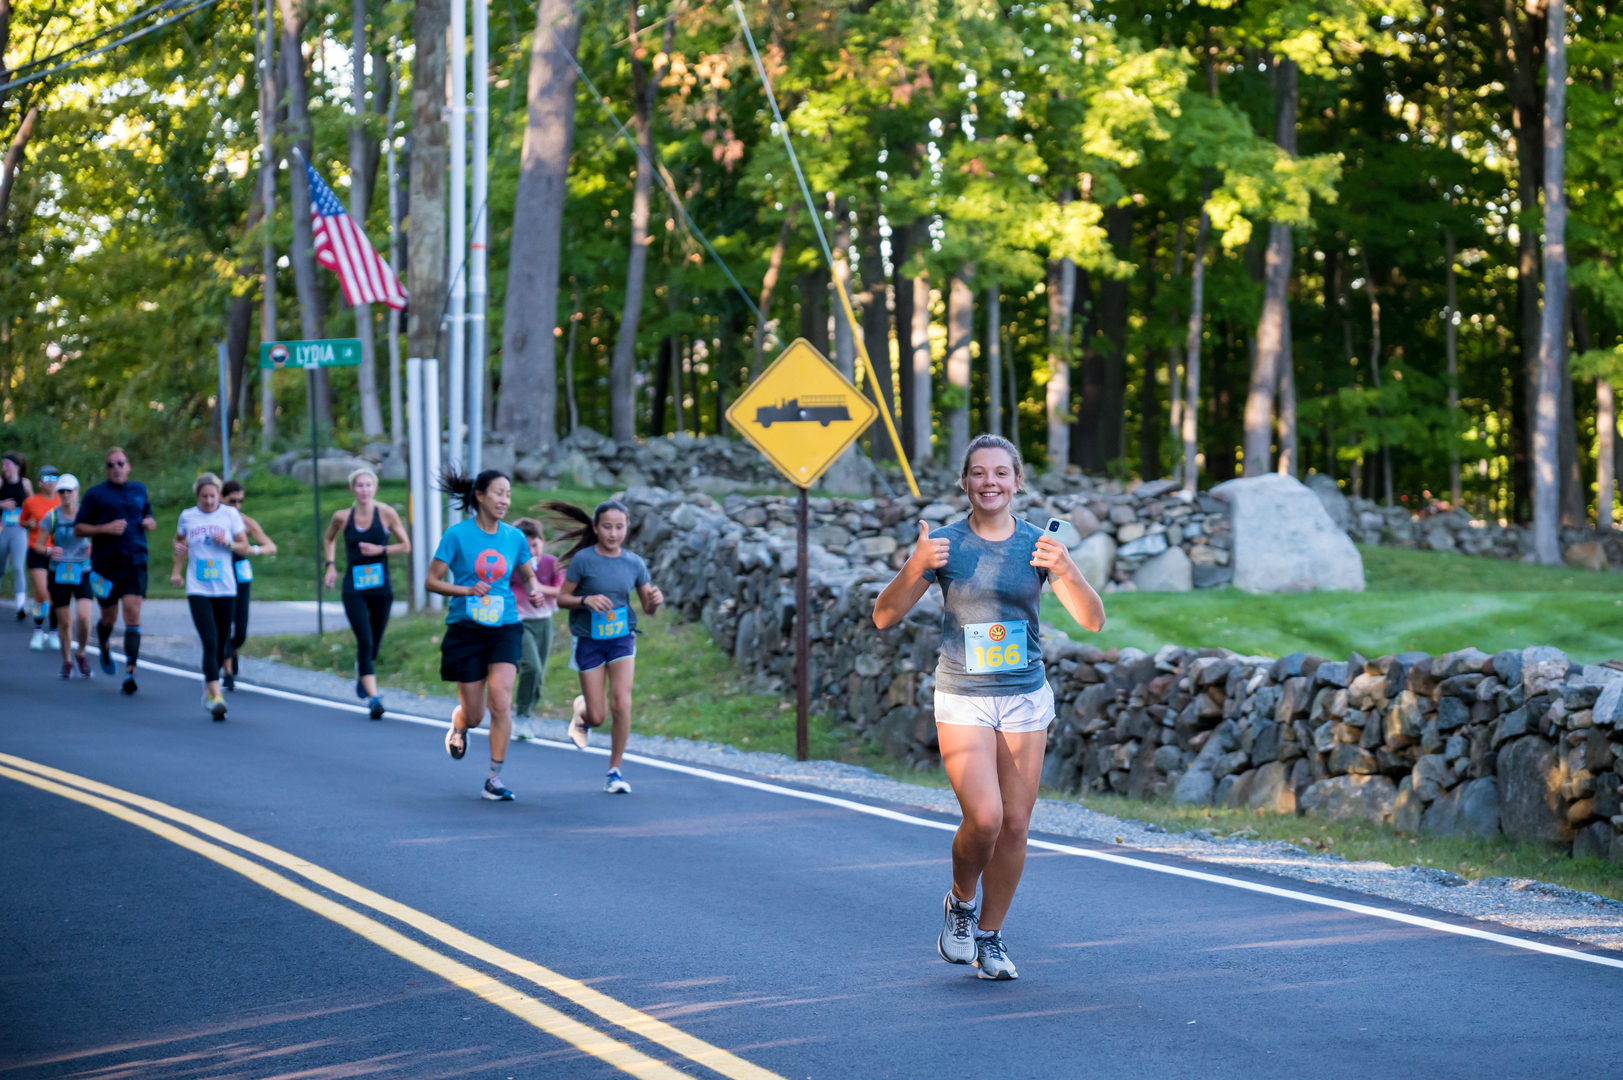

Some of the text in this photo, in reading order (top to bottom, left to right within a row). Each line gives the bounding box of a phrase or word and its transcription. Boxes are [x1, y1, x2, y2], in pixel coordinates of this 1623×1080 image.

[296, 343, 335, 364] LYDIA
[471, 608, 499, 622] 156
[597, 621, 623, 636] 157
[973, 643, 1020, 667] 166
